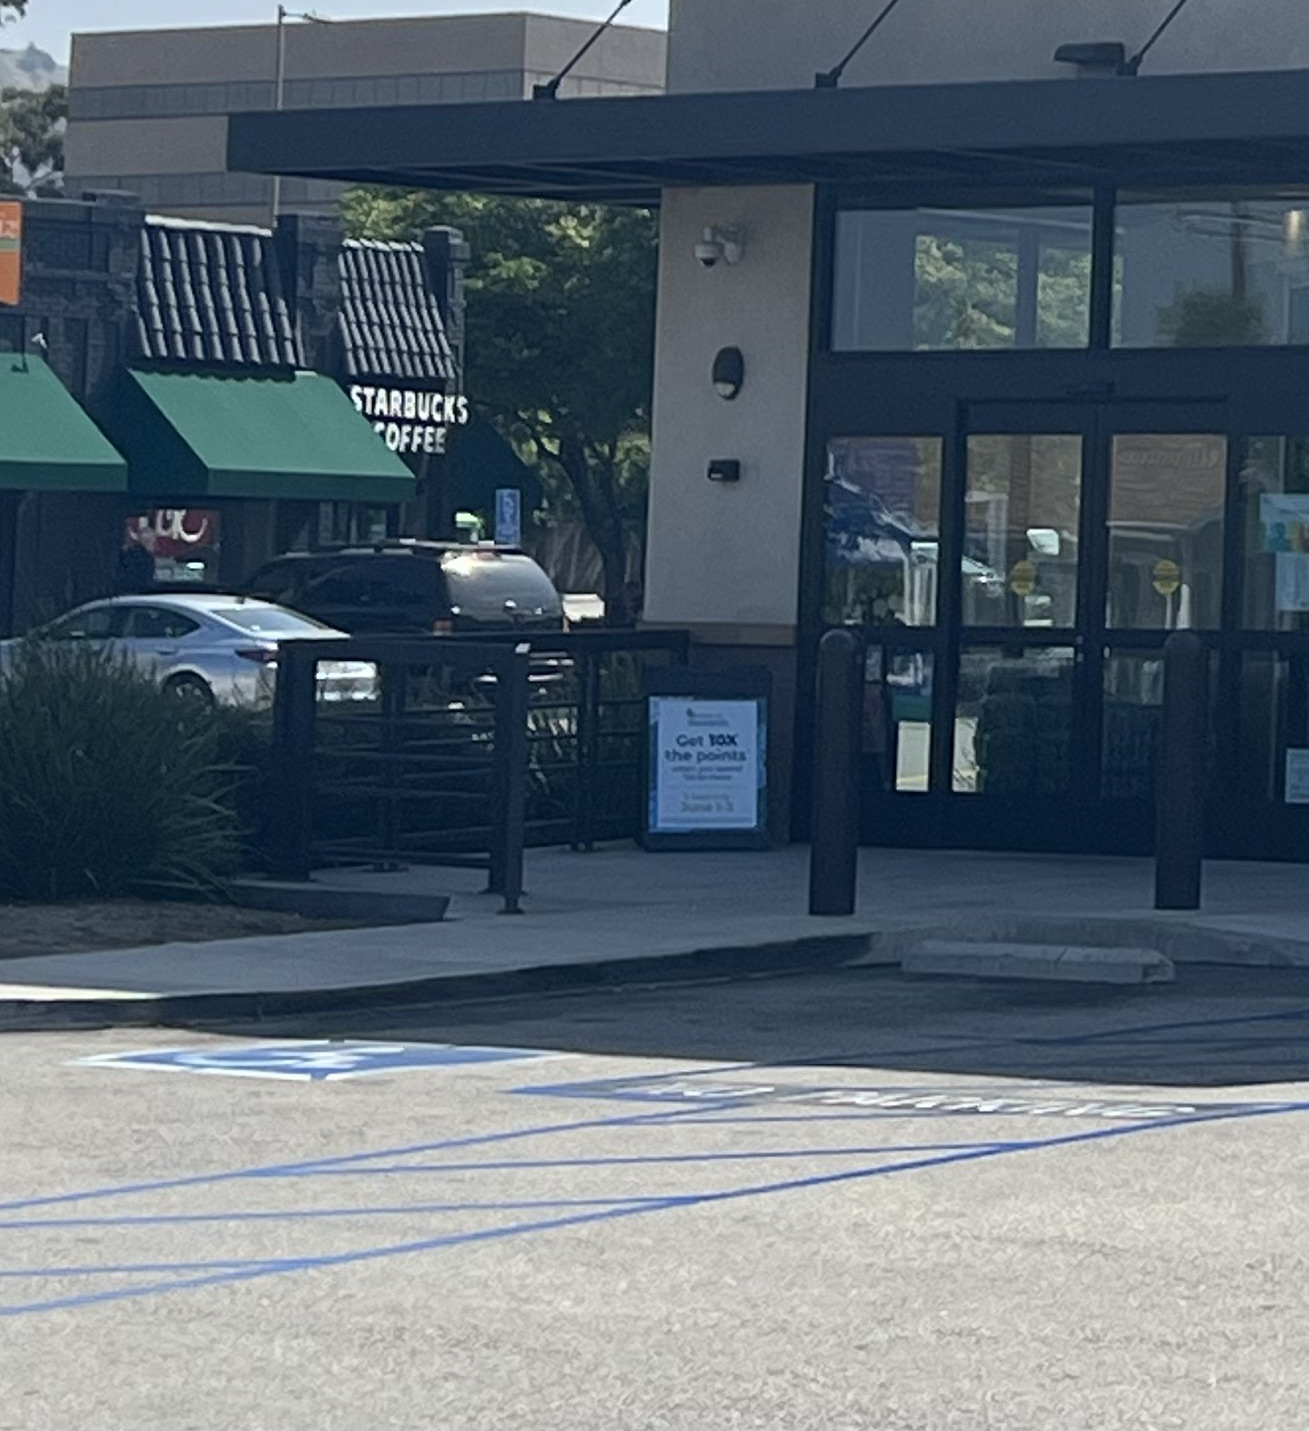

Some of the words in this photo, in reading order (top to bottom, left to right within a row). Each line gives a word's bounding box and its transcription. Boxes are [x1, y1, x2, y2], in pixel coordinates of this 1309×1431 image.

[351, 384, 468, 423] STARBUCKS
[675, 733, 704, 747] Get
[664, 749, 692, 762] the
[696, 750, 747, 764] points
